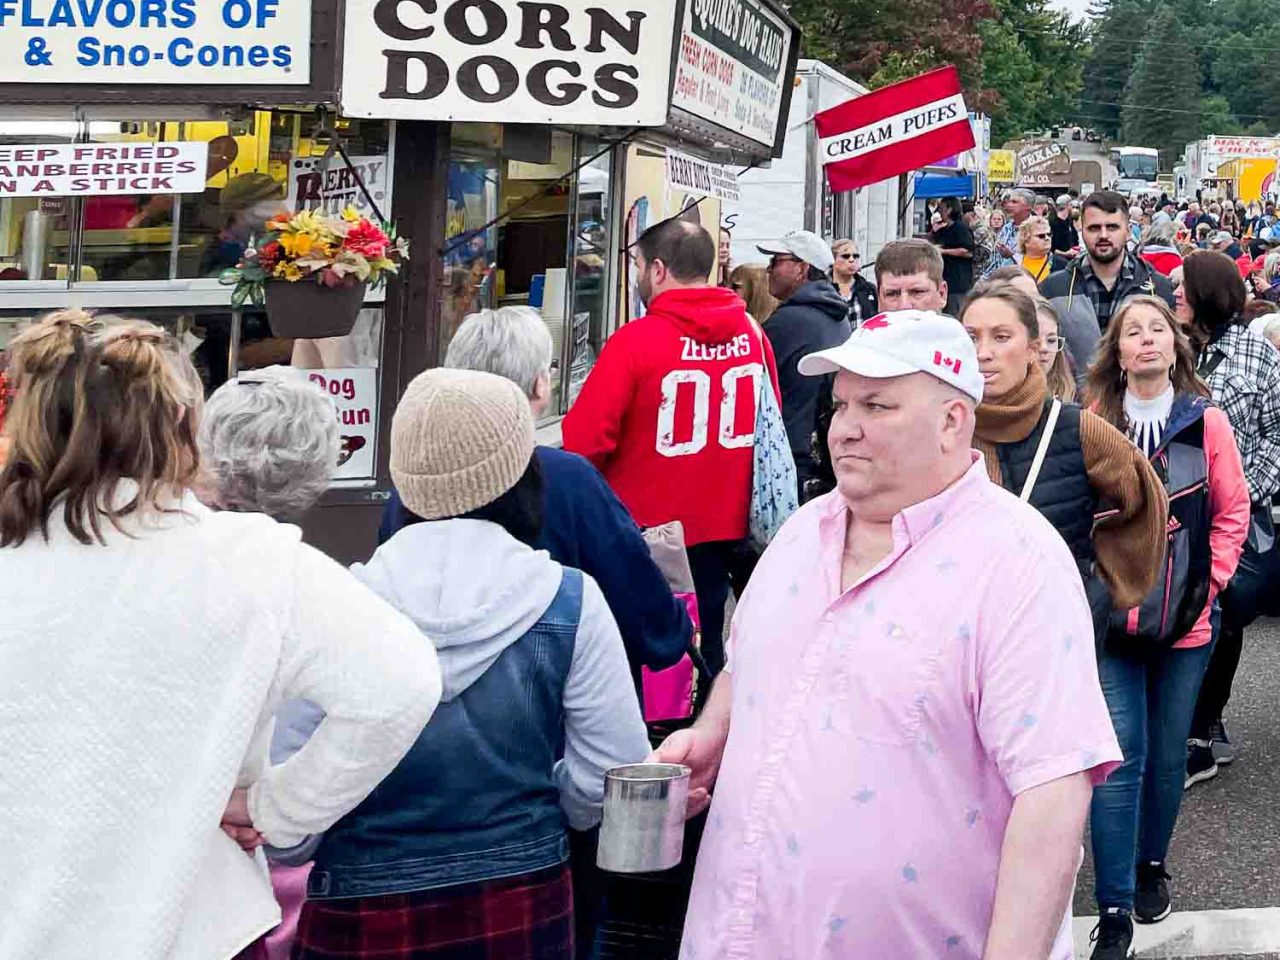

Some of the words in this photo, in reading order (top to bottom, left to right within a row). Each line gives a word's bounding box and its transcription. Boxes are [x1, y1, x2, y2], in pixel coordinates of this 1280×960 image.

[24, 36, 53, 66] &
[77, 37, 292, 67] Sno-Cones
[739, 9, 760, 56] DOG
[759, 25, 783, 70] HAUS
[379, 50, 639, 109] DOGS
[827, 124, 893, 157] CREAM
[903, 103, 957, 135] PUFFS
[74, 147, 180, 161] FRIED
[32, 180, 55, 192] A
[71, 177, 173, 191] STICK
[336, 406, 370, 425] un
[655, 362, 764, 457] 00
